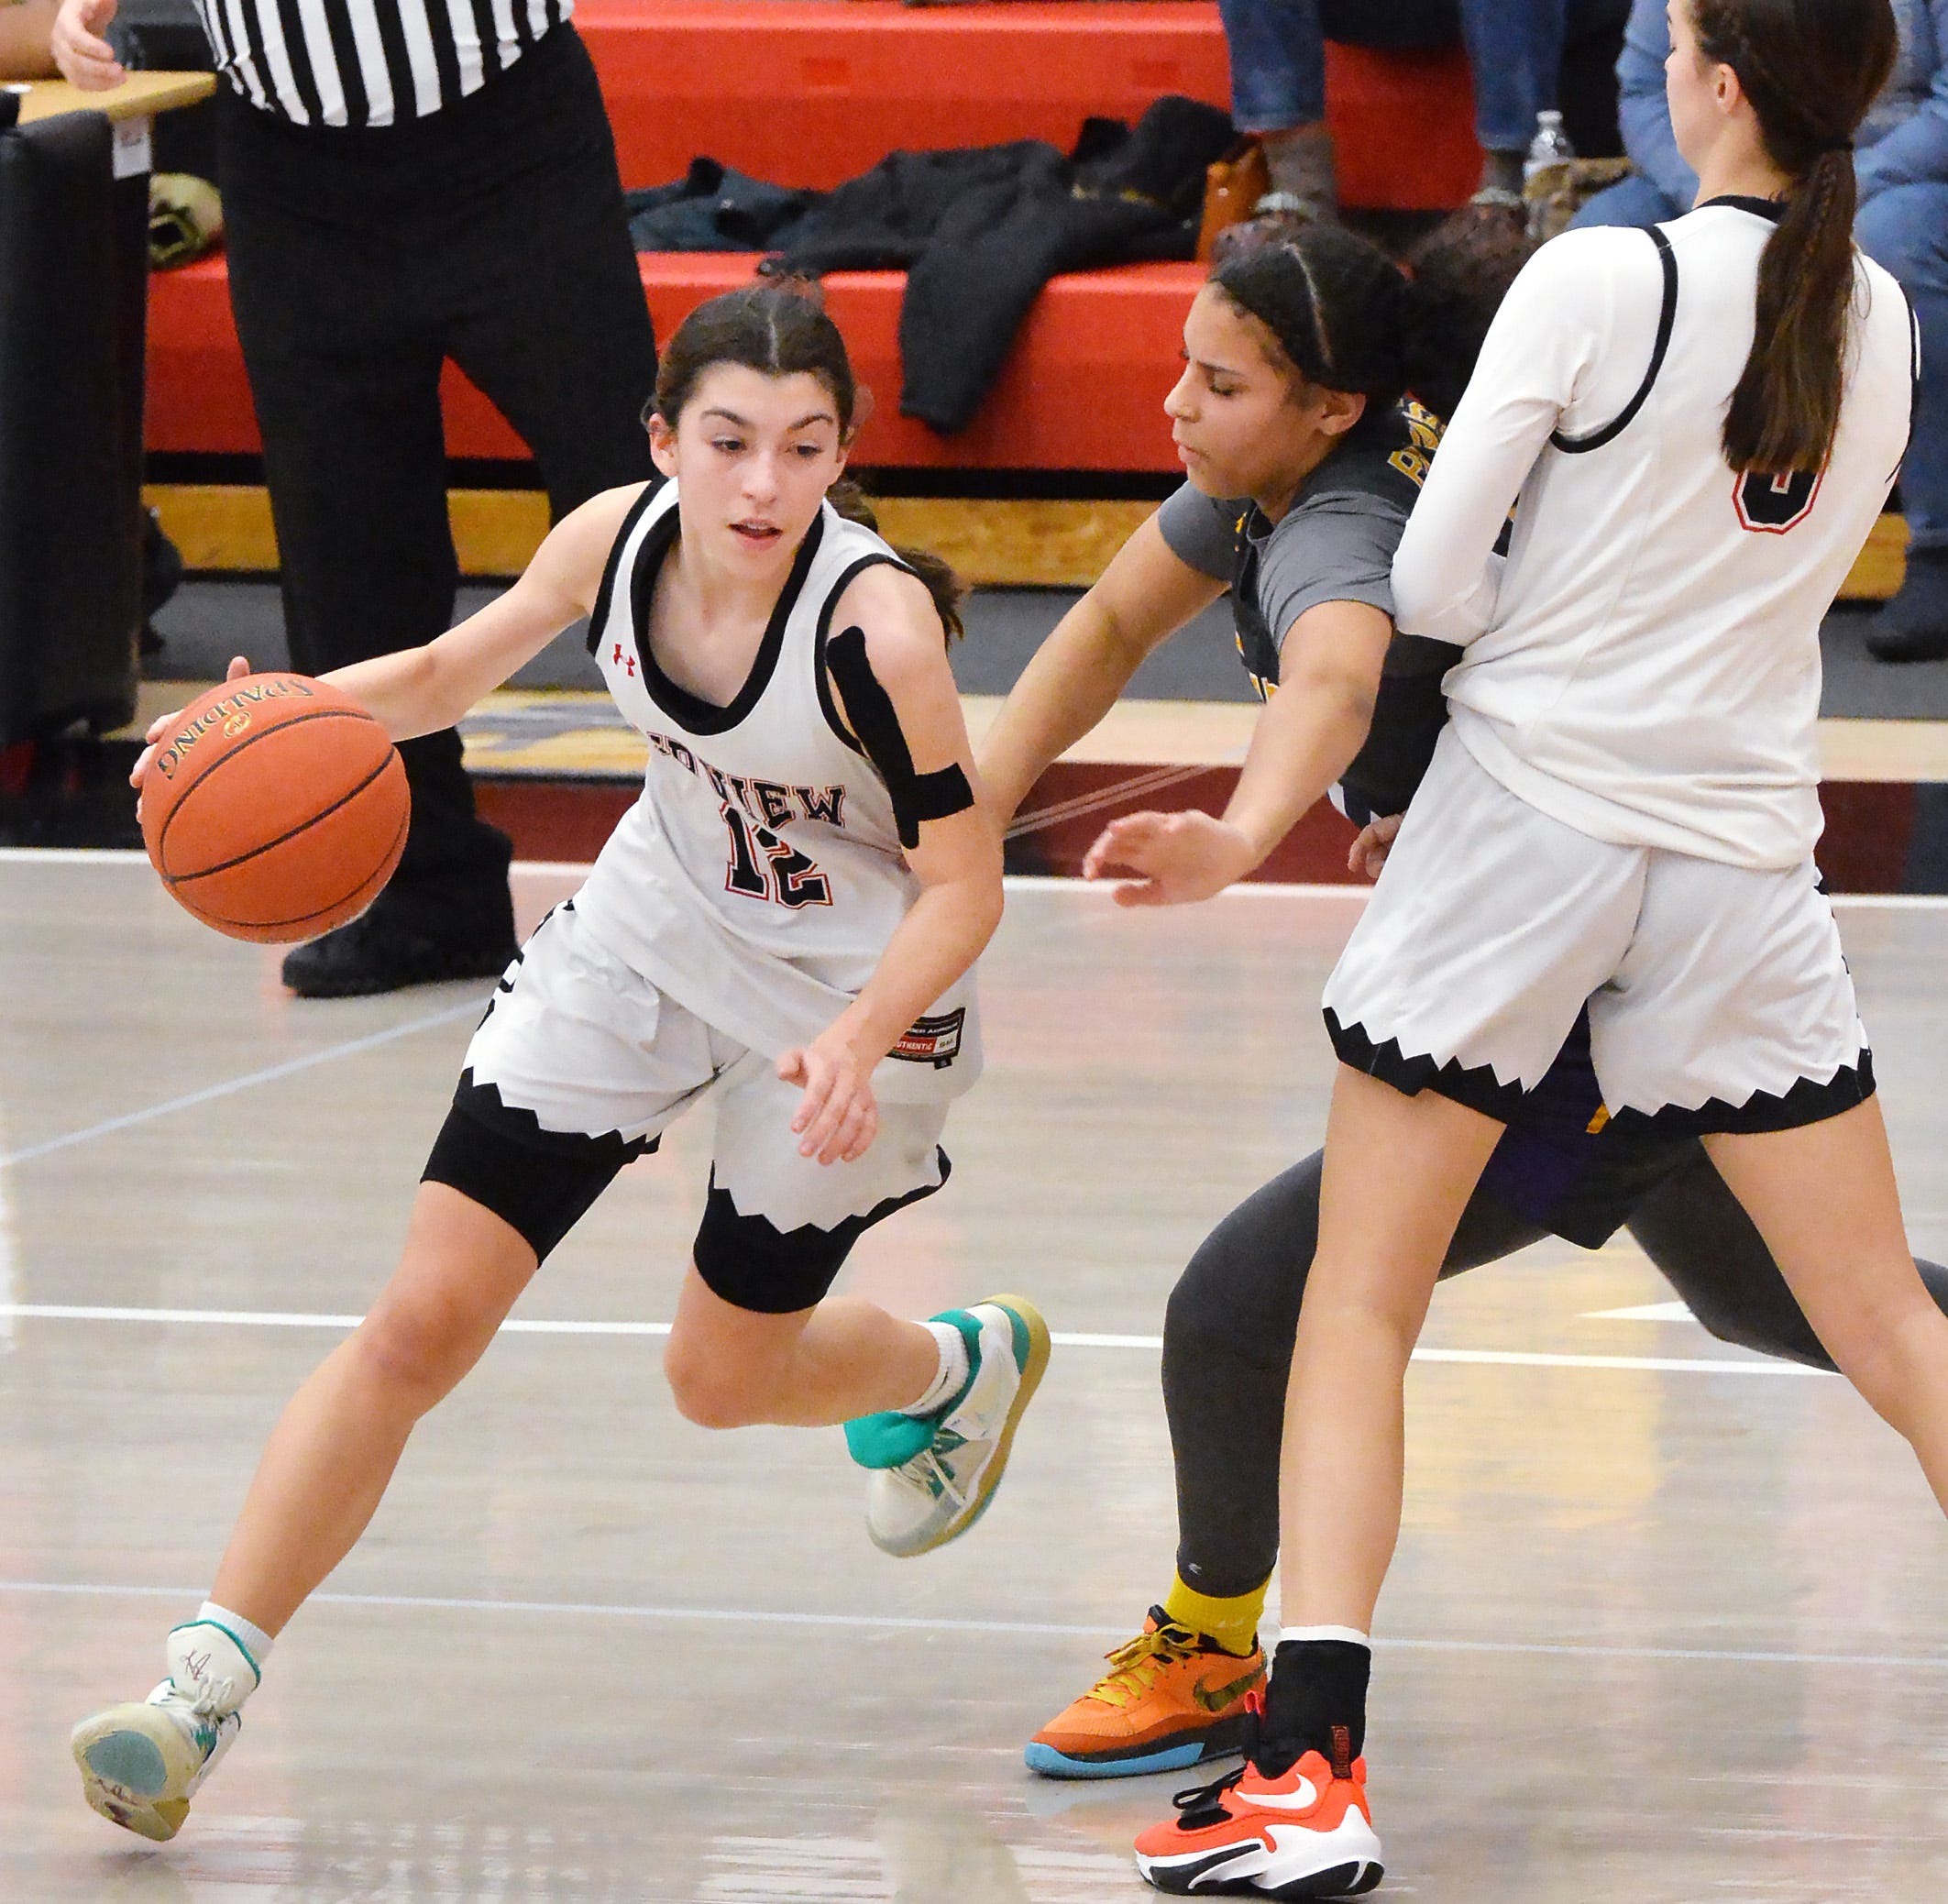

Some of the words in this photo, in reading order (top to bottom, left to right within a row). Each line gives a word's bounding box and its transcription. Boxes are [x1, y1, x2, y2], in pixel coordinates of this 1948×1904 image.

[157, 677, 314, 781] SPALDING
[719, 799, 833, 909] 12
[897, 1040, 933, 1051] UTHENTIC
